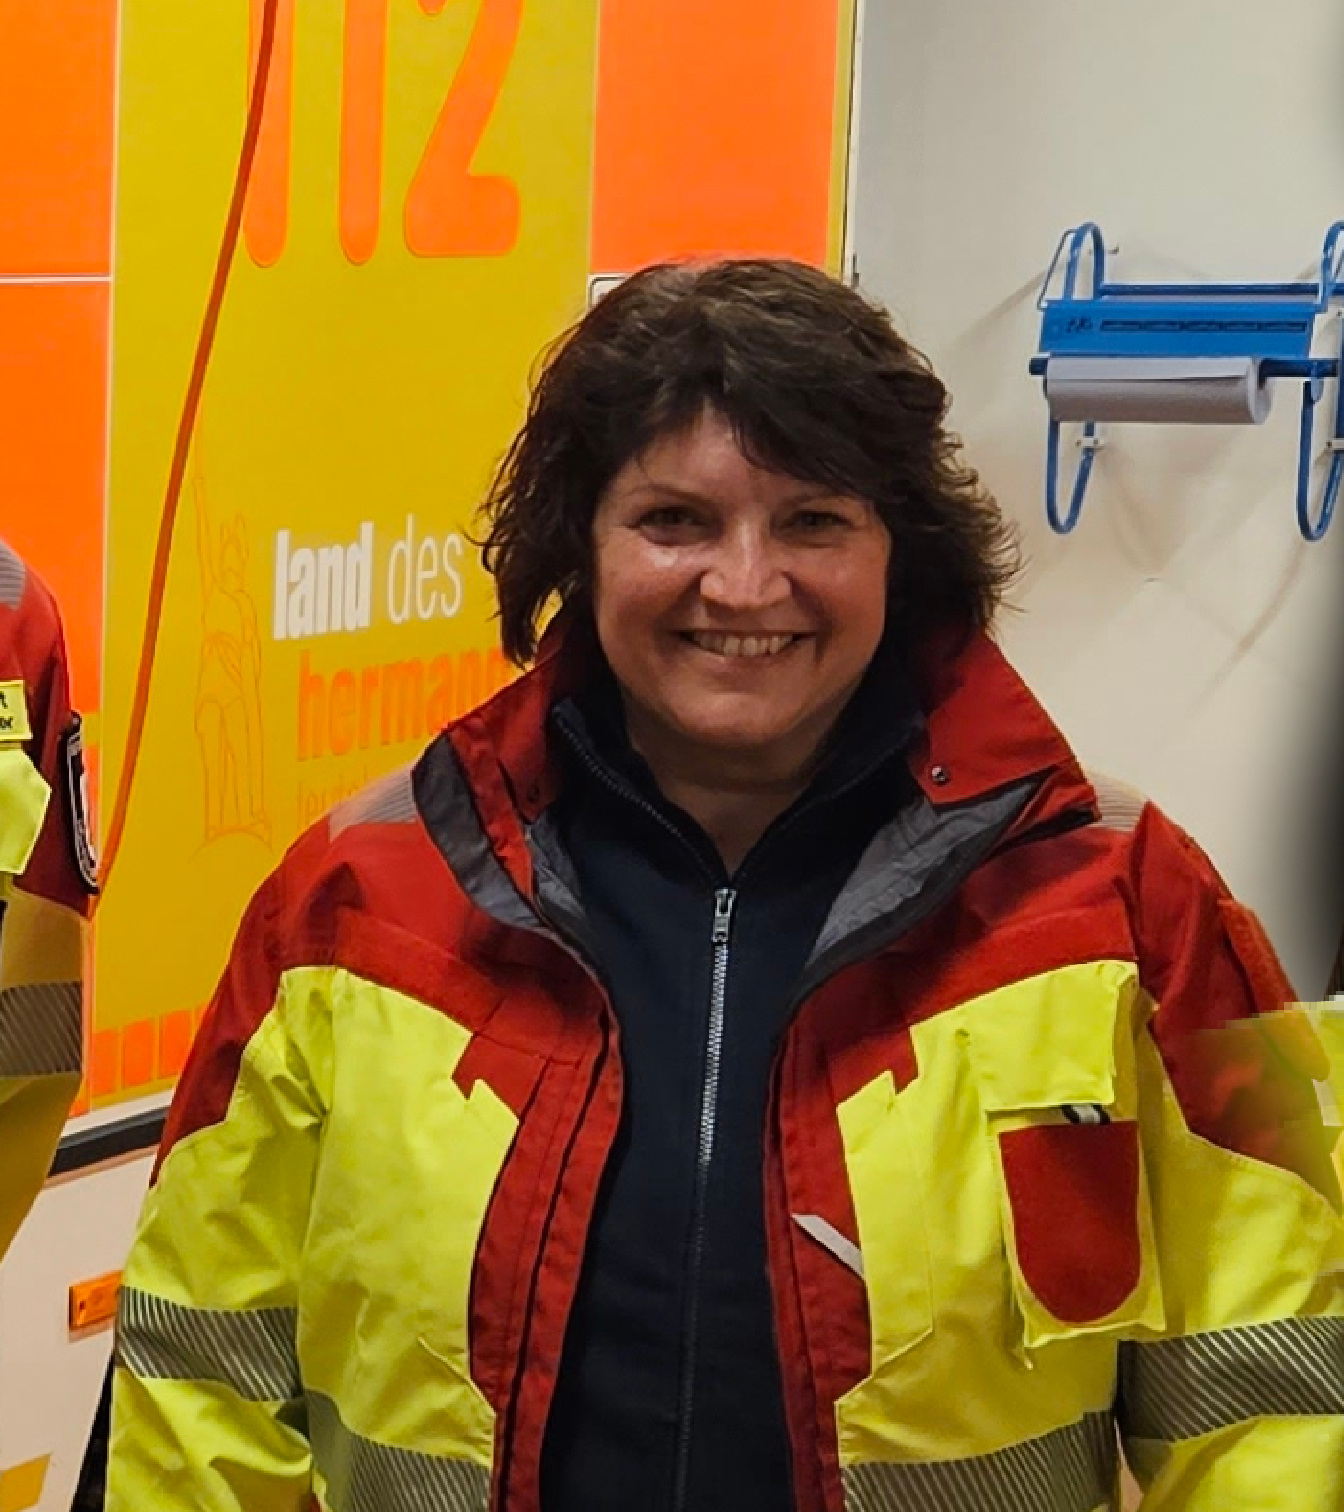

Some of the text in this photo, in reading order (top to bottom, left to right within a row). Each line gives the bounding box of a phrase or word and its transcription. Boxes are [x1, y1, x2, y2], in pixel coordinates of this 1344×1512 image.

[244, 0, 524, 267] 112
[273, 513, 464, 641] land des
